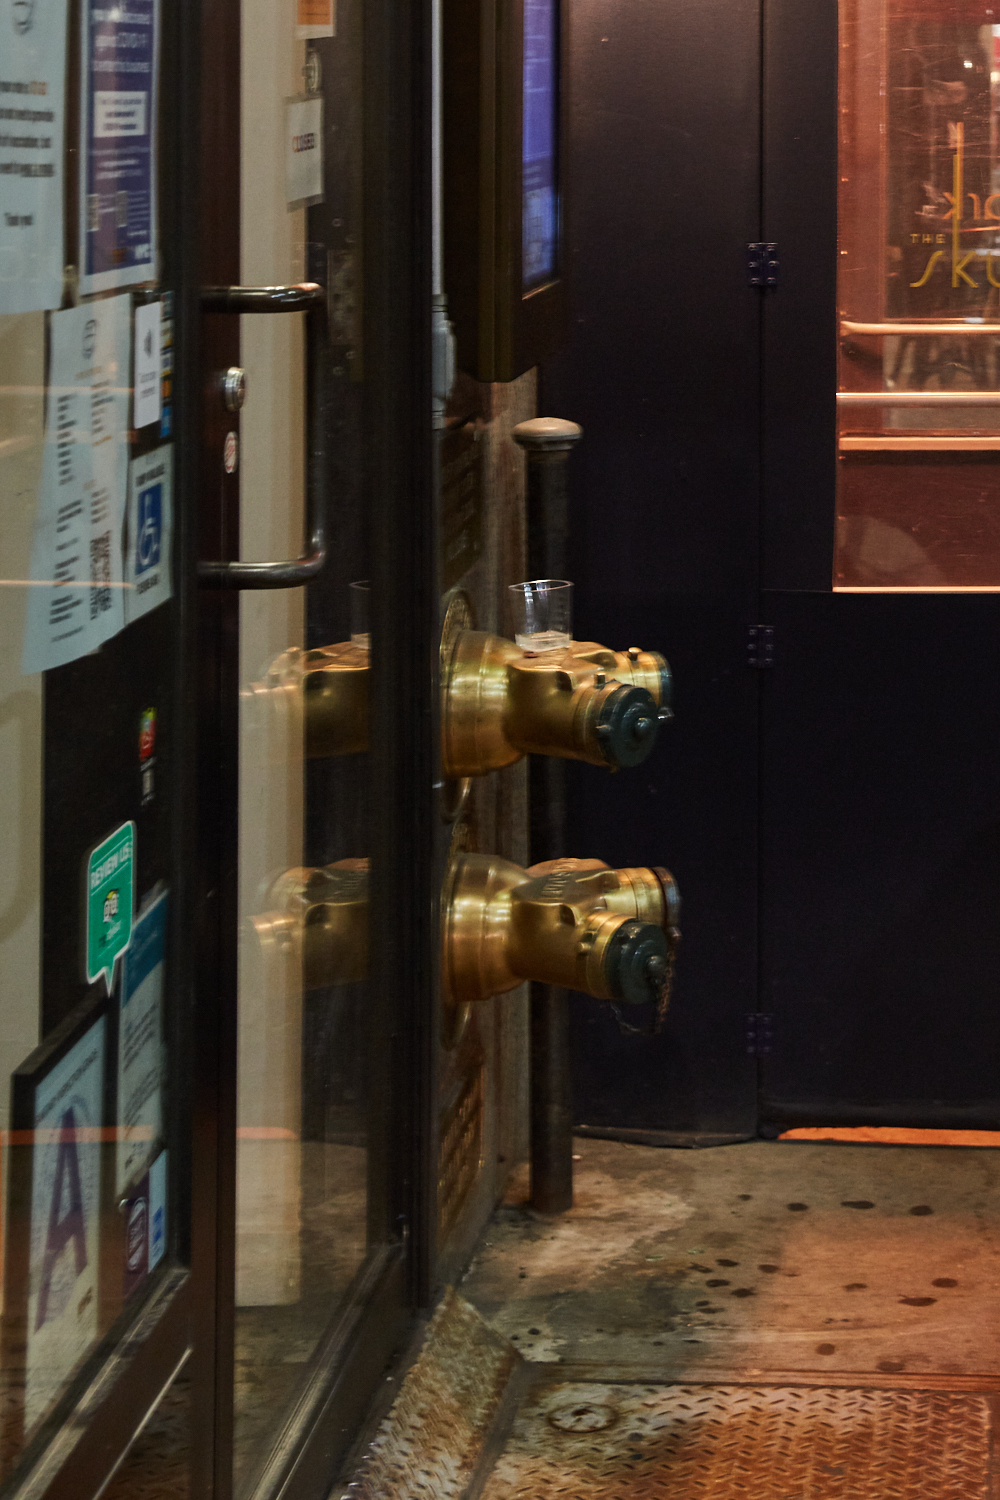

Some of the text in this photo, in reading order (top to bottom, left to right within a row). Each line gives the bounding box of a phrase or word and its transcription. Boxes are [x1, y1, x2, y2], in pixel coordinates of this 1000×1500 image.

[291, 132, 316, 153] CLOSED
[909, 233, 946, 244] THE
[35, 1104, 88, 1333] A
